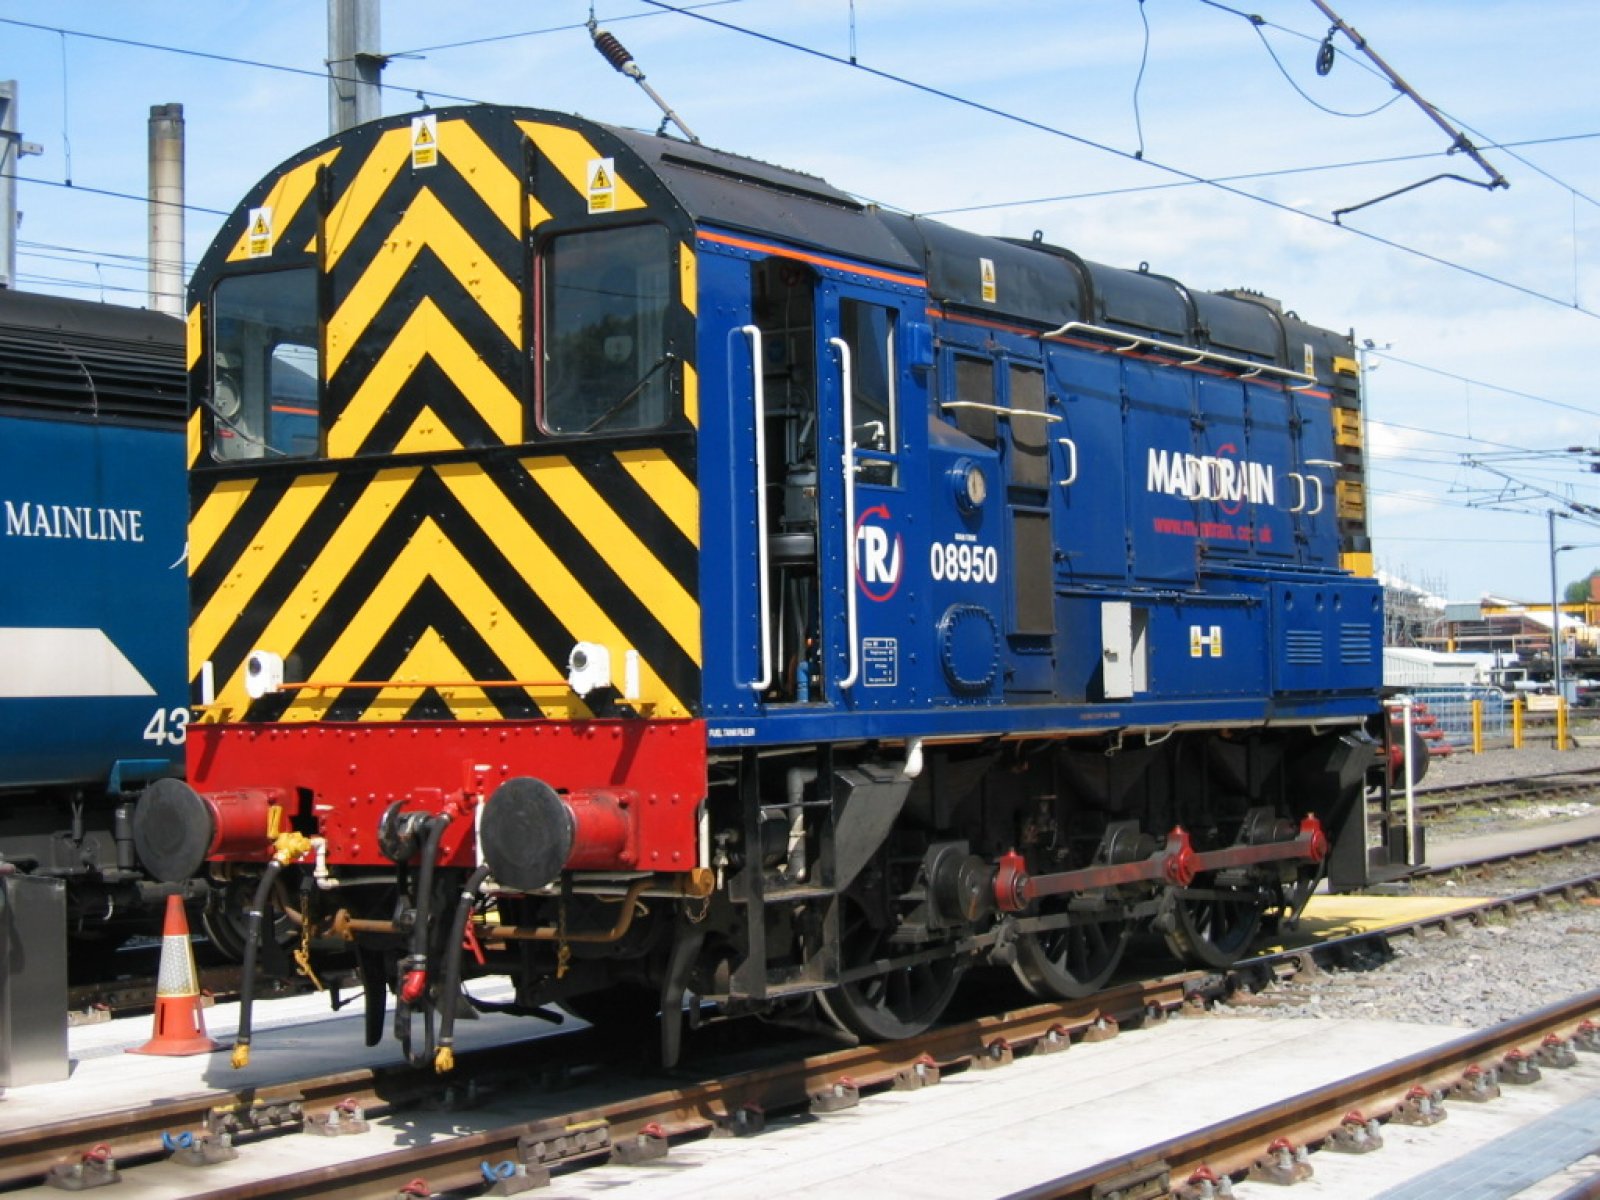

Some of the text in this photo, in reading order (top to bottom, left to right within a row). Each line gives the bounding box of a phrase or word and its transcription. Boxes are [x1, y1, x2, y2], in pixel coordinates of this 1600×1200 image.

[5, 500, 144, 542] MAINLINE
[930, 541, 998, 584] 08950
[143, 707, 188, 746] 43
